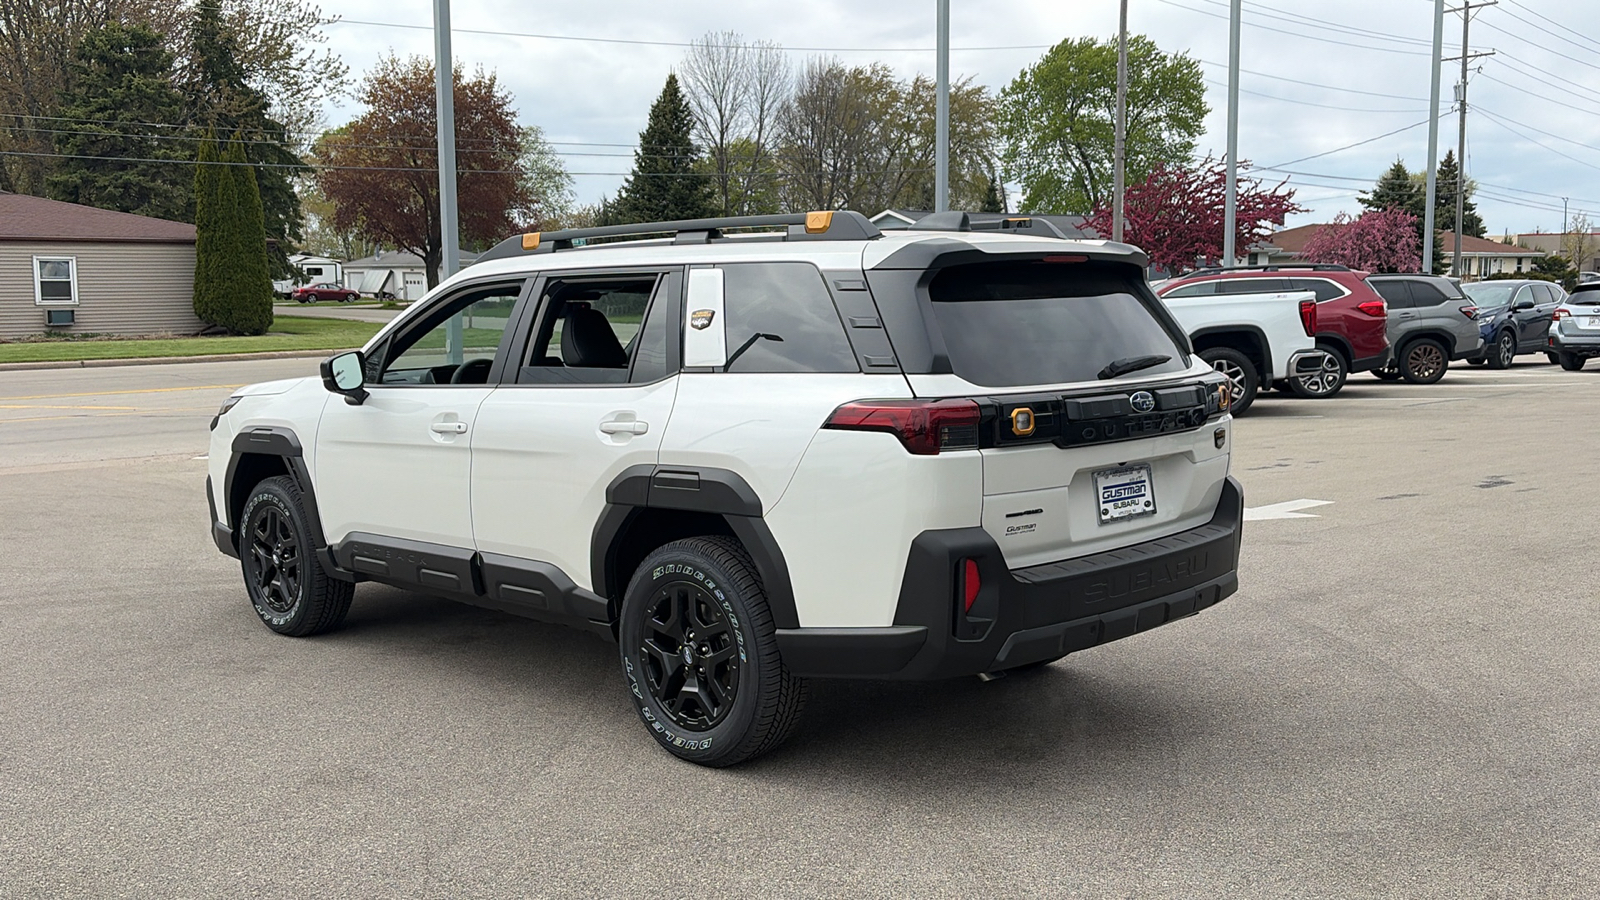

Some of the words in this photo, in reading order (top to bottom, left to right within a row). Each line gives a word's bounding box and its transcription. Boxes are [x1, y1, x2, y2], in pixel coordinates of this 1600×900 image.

[1082, 411, 1200, 439] OUTBACK
[1112, 499, 1139, 509] SUBARU
[352, 544, 427, 566] OUTBACK
[1083, 551, 1209, 604] SUBARU
[652, 564, 747, 663] BRIDGESTONE
[624, 656, 643, 699] A/T
[641, 706, 713, 750] DUELER
